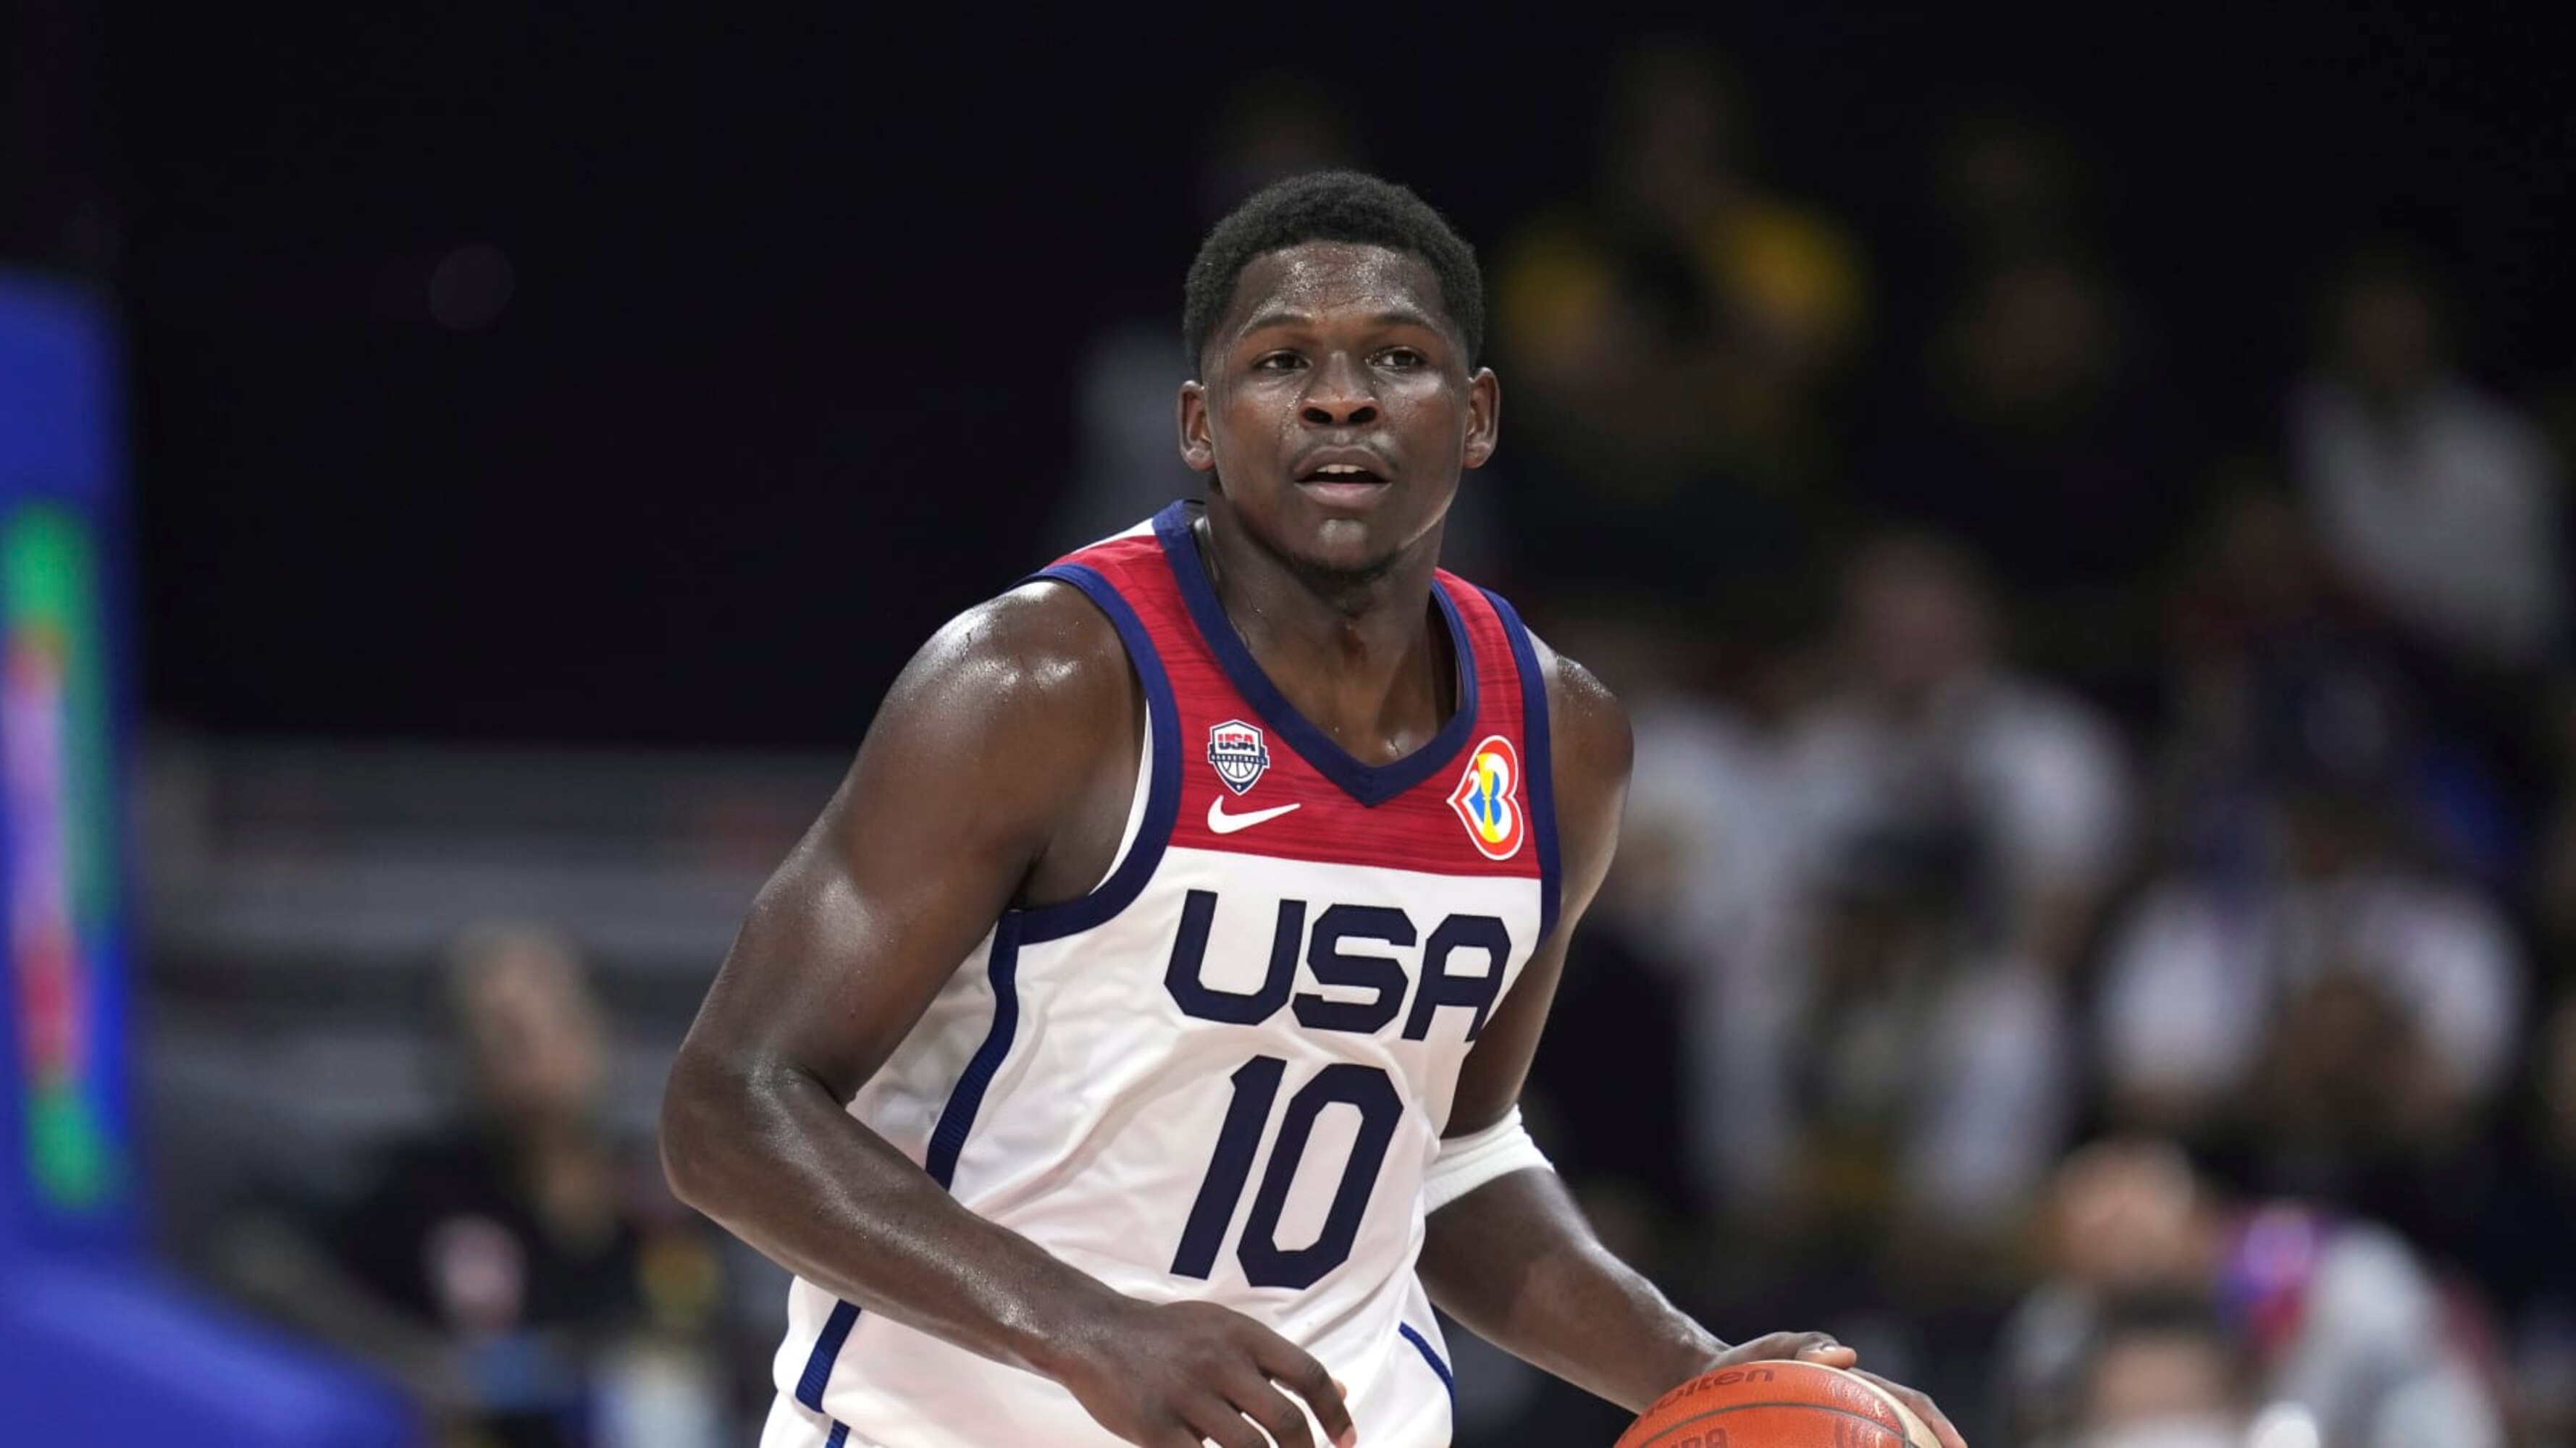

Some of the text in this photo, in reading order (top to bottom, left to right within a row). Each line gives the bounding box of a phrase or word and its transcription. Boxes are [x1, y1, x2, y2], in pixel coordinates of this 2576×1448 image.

[1217, 733, 1256, 752] USA
[1164, 889, 1512, 1043] USA
[1170, 1054, 1404, 1290] 10
